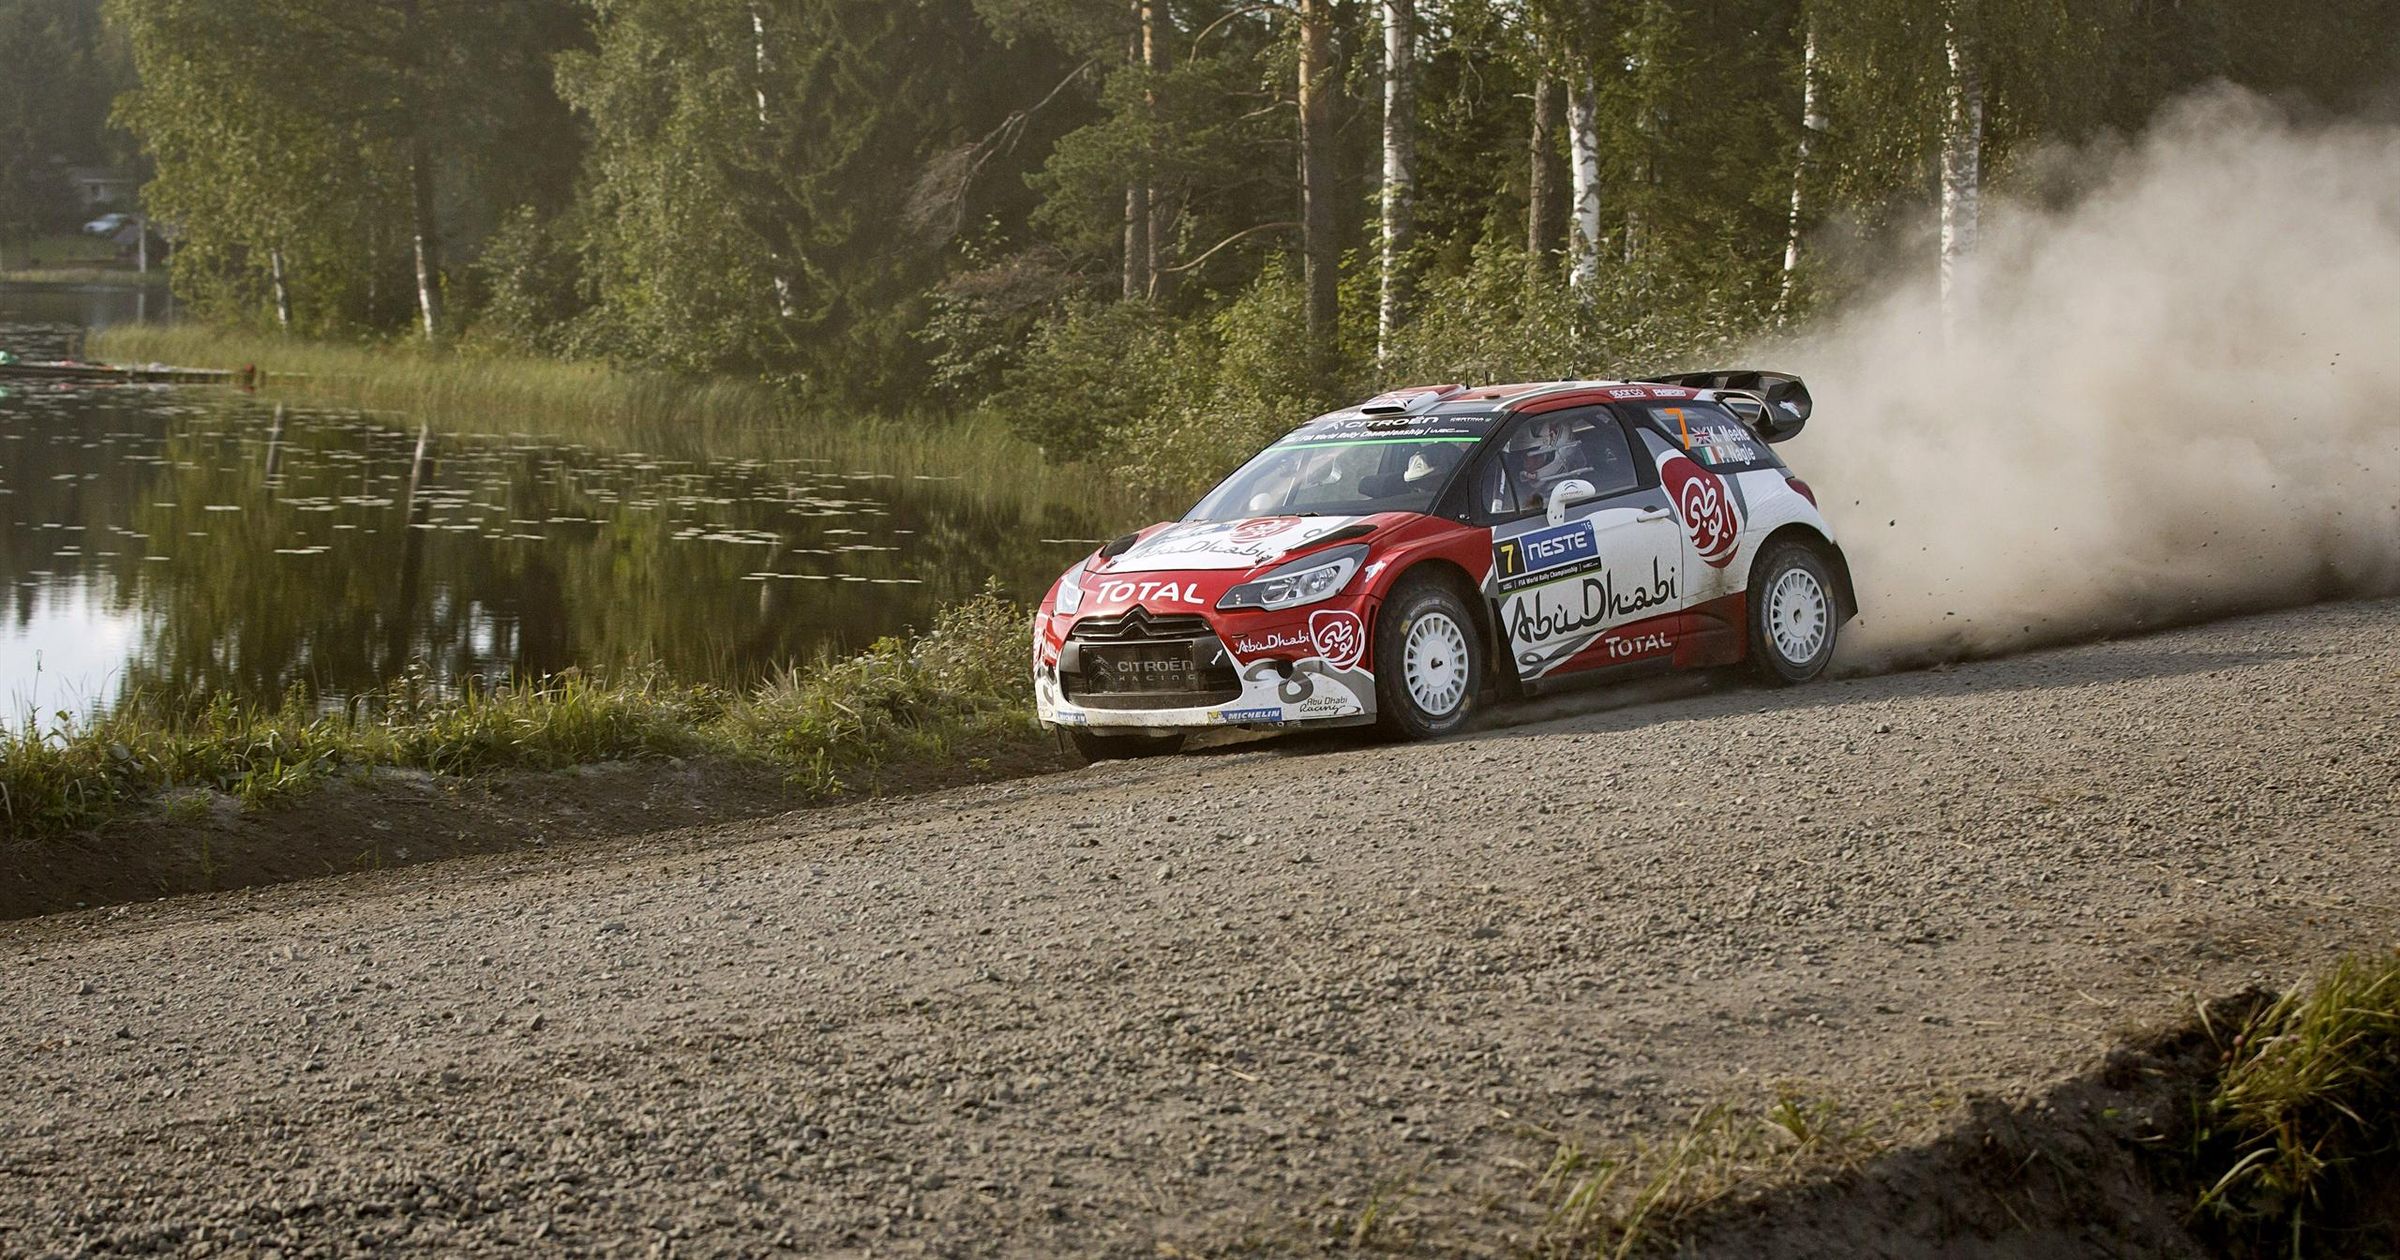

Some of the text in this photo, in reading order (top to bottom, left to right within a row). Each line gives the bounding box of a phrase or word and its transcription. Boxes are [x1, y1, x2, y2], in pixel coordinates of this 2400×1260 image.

[1346, 415, 1440, 430] CITROËN
[1663, 407, 1691, 451] 7
[1360, 426, 1424, 438] Championship
[1719, 425, 1750, 442] Meeke
[1730, 444, 1756, 466] Nagle
[1527, 531, 1588, 561] NESTE
[1500, 544, 1514, 574] 7
[1527, 574, 1539, 585] World
[1539, 571, 1550, 582] Rally
[1550, 565, 1578, 578] Championship
[1095, 580, 1205, 604] TOTAL
[1605, 631, 1672, 658] TOTAL
[1117, 657, 1194, 673] CITROËN
[1300, 704, 1346, 715] Racing
[1306, 696, 1347, 706] Abu Dhabi
[1228, 709, 1282, 720] MICHELIN
